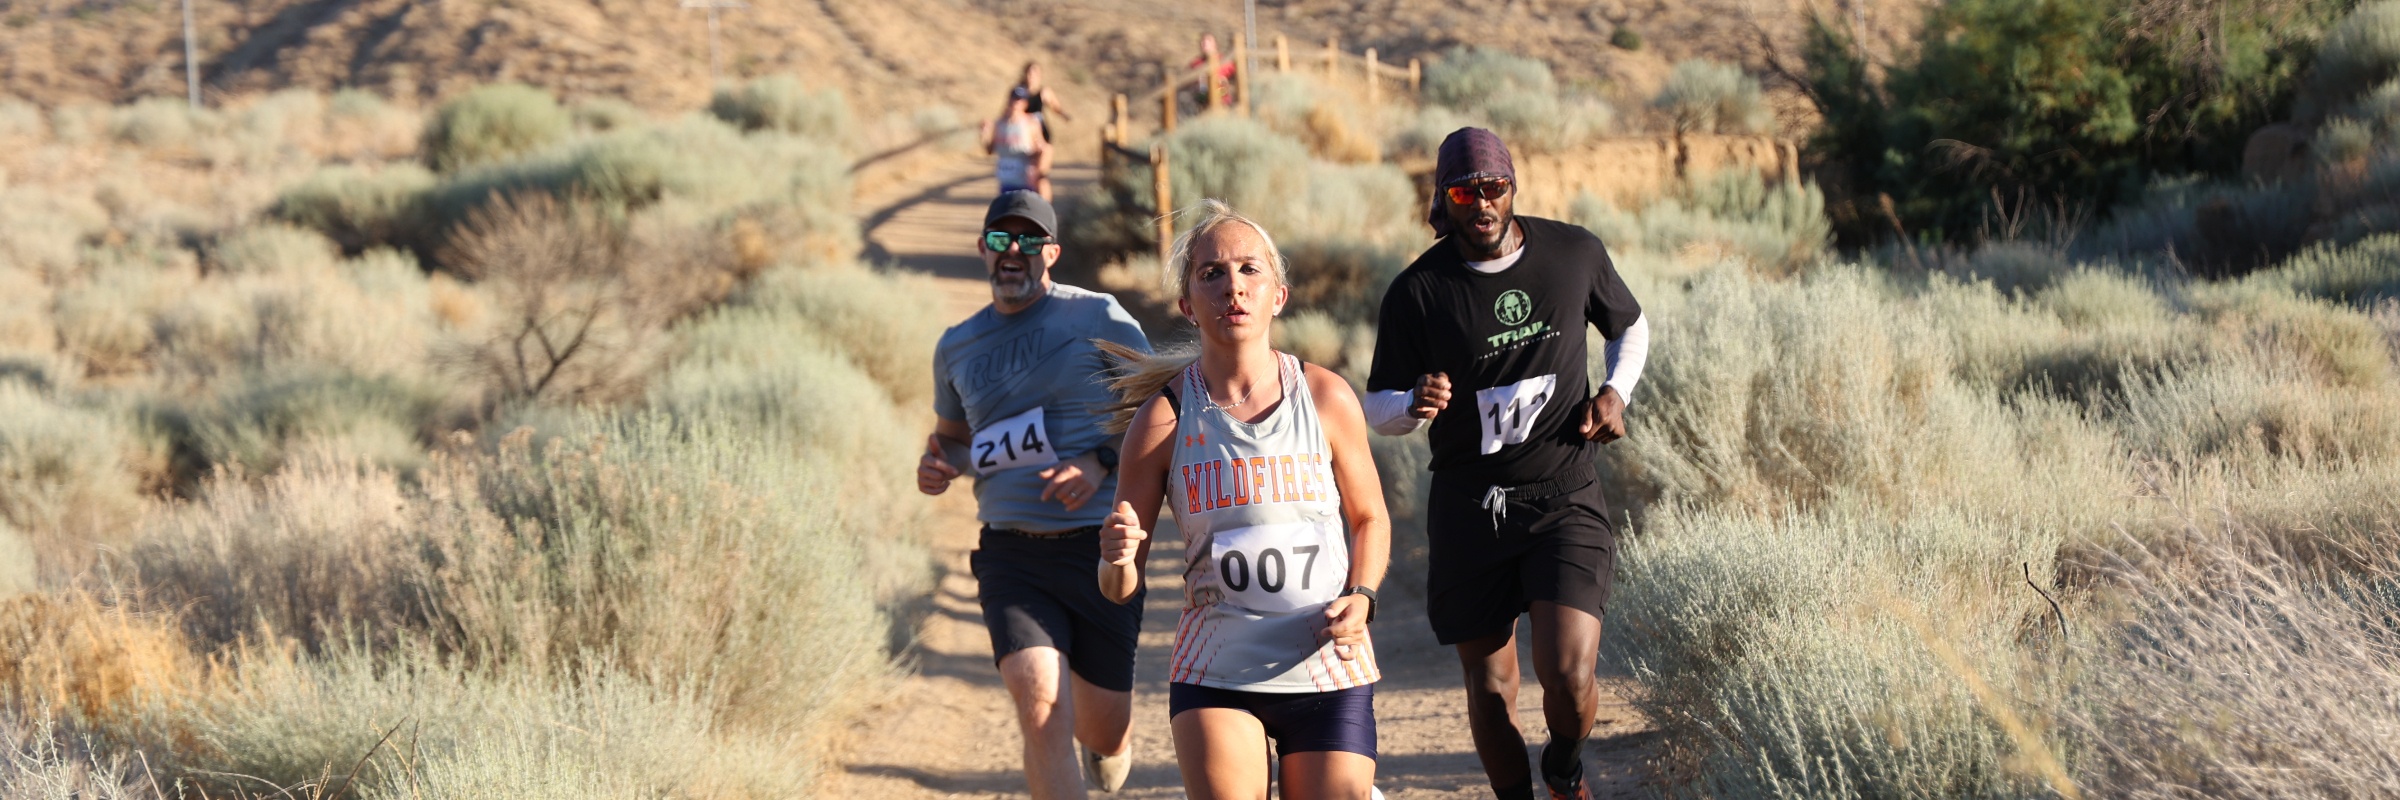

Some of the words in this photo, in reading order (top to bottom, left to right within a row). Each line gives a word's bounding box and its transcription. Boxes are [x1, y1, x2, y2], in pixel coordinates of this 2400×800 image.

[1487, 321, 1551, 348] TRAIL
[965, 328, 1044, 398] RUN
[976, 423, 1044, 468] 214
[1182, 453, 1327, 515] WILDFIRES
[1220, 544, 1320, 594] 007
